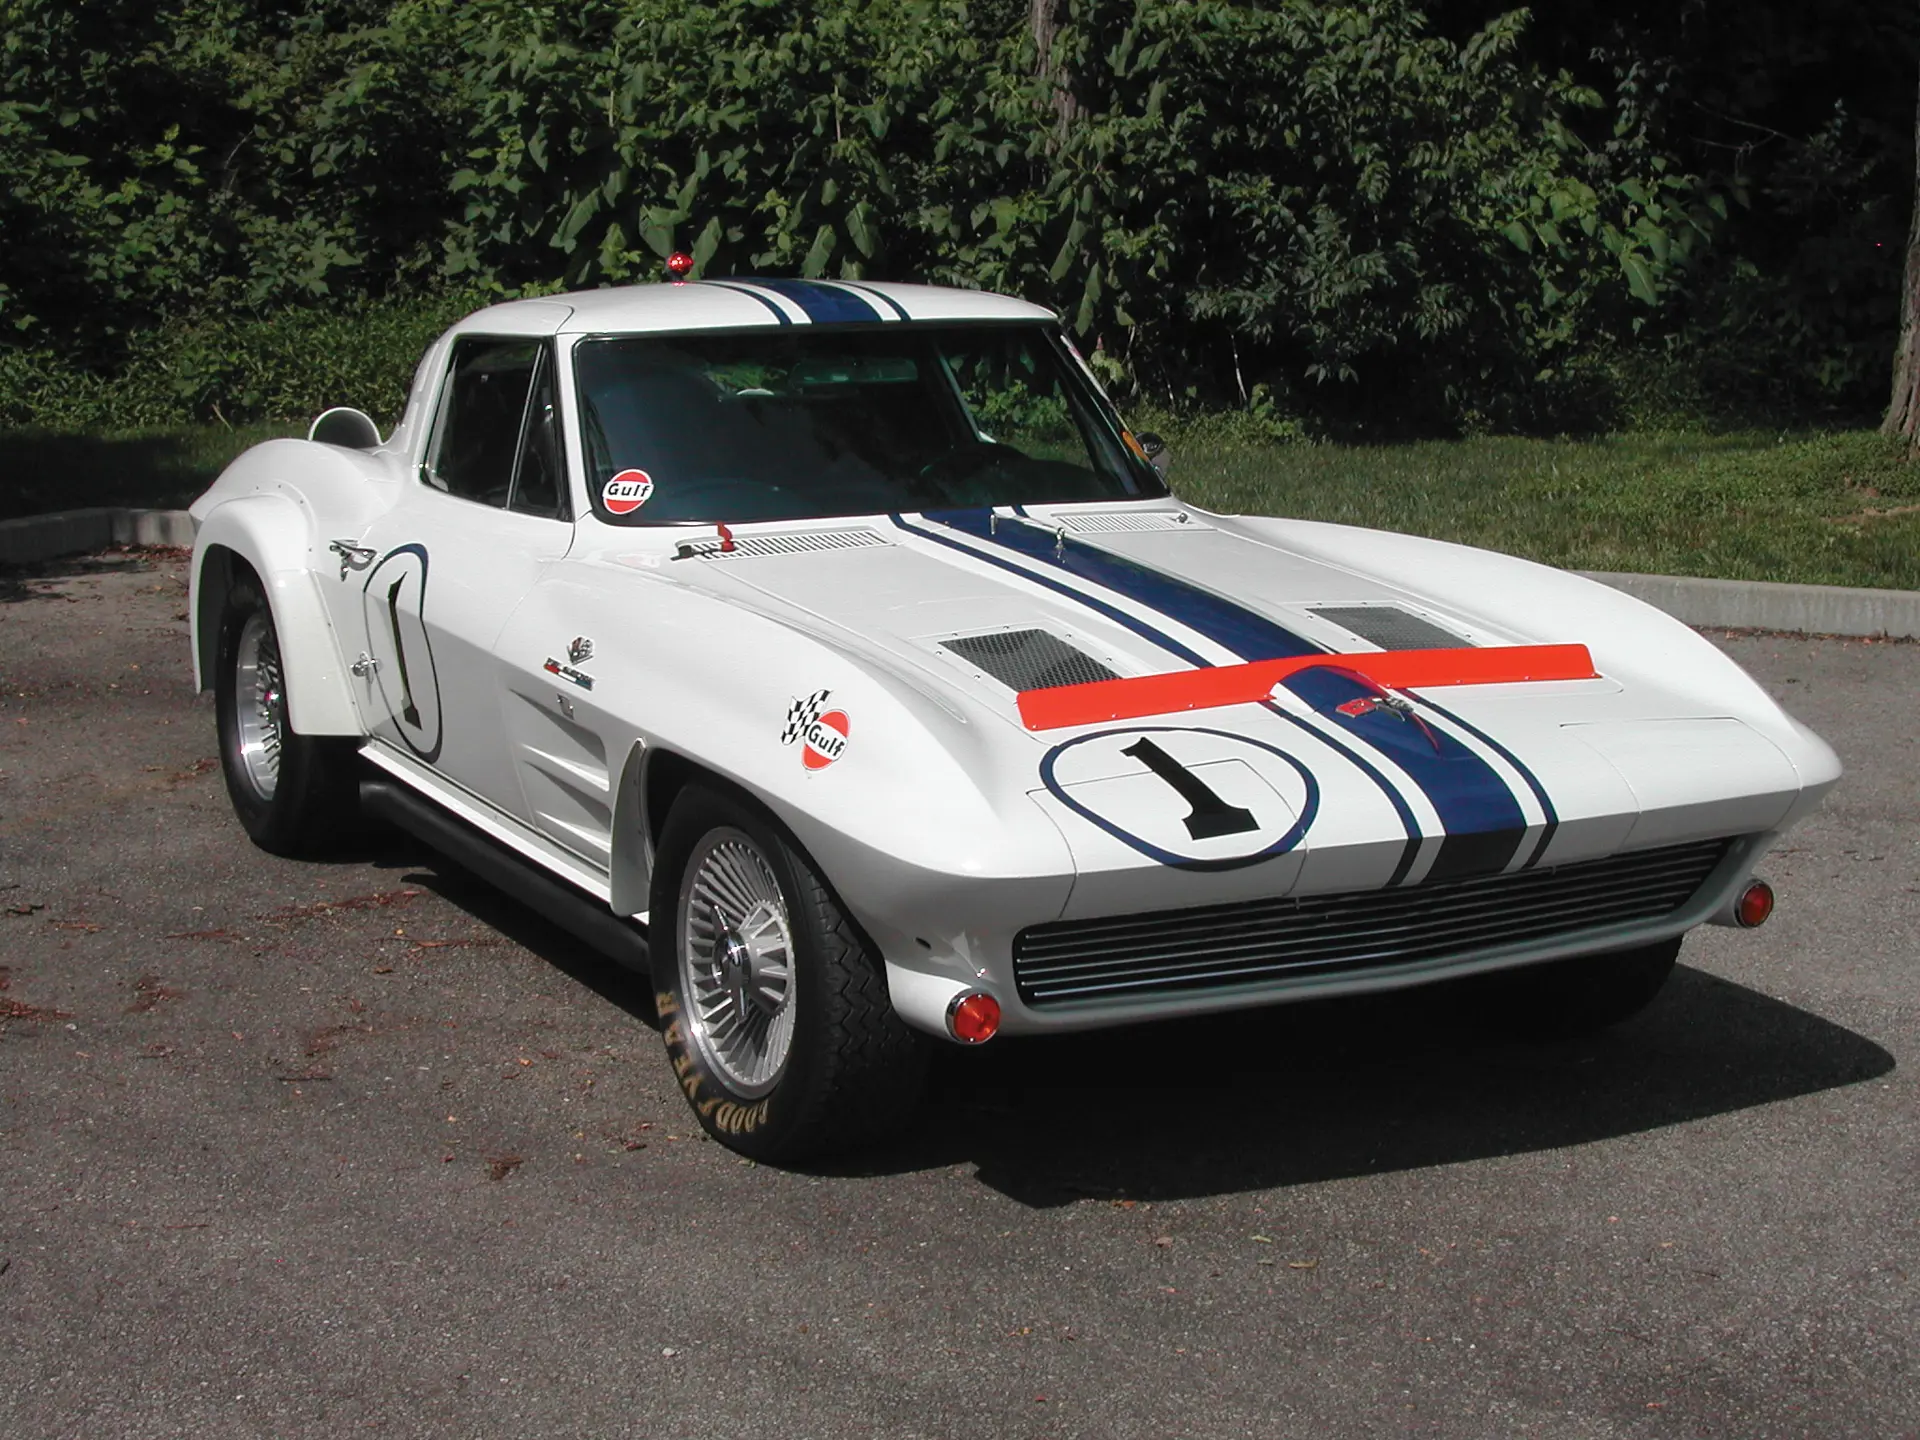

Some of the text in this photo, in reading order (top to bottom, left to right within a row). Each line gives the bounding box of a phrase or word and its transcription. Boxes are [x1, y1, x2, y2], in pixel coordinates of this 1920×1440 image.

[608, 483, 650, 497] Gulf
[388, 571, 422, 731] 1
[808, 724, 845, 757] Gulf
[1120, 737, 1260, 840] 1
